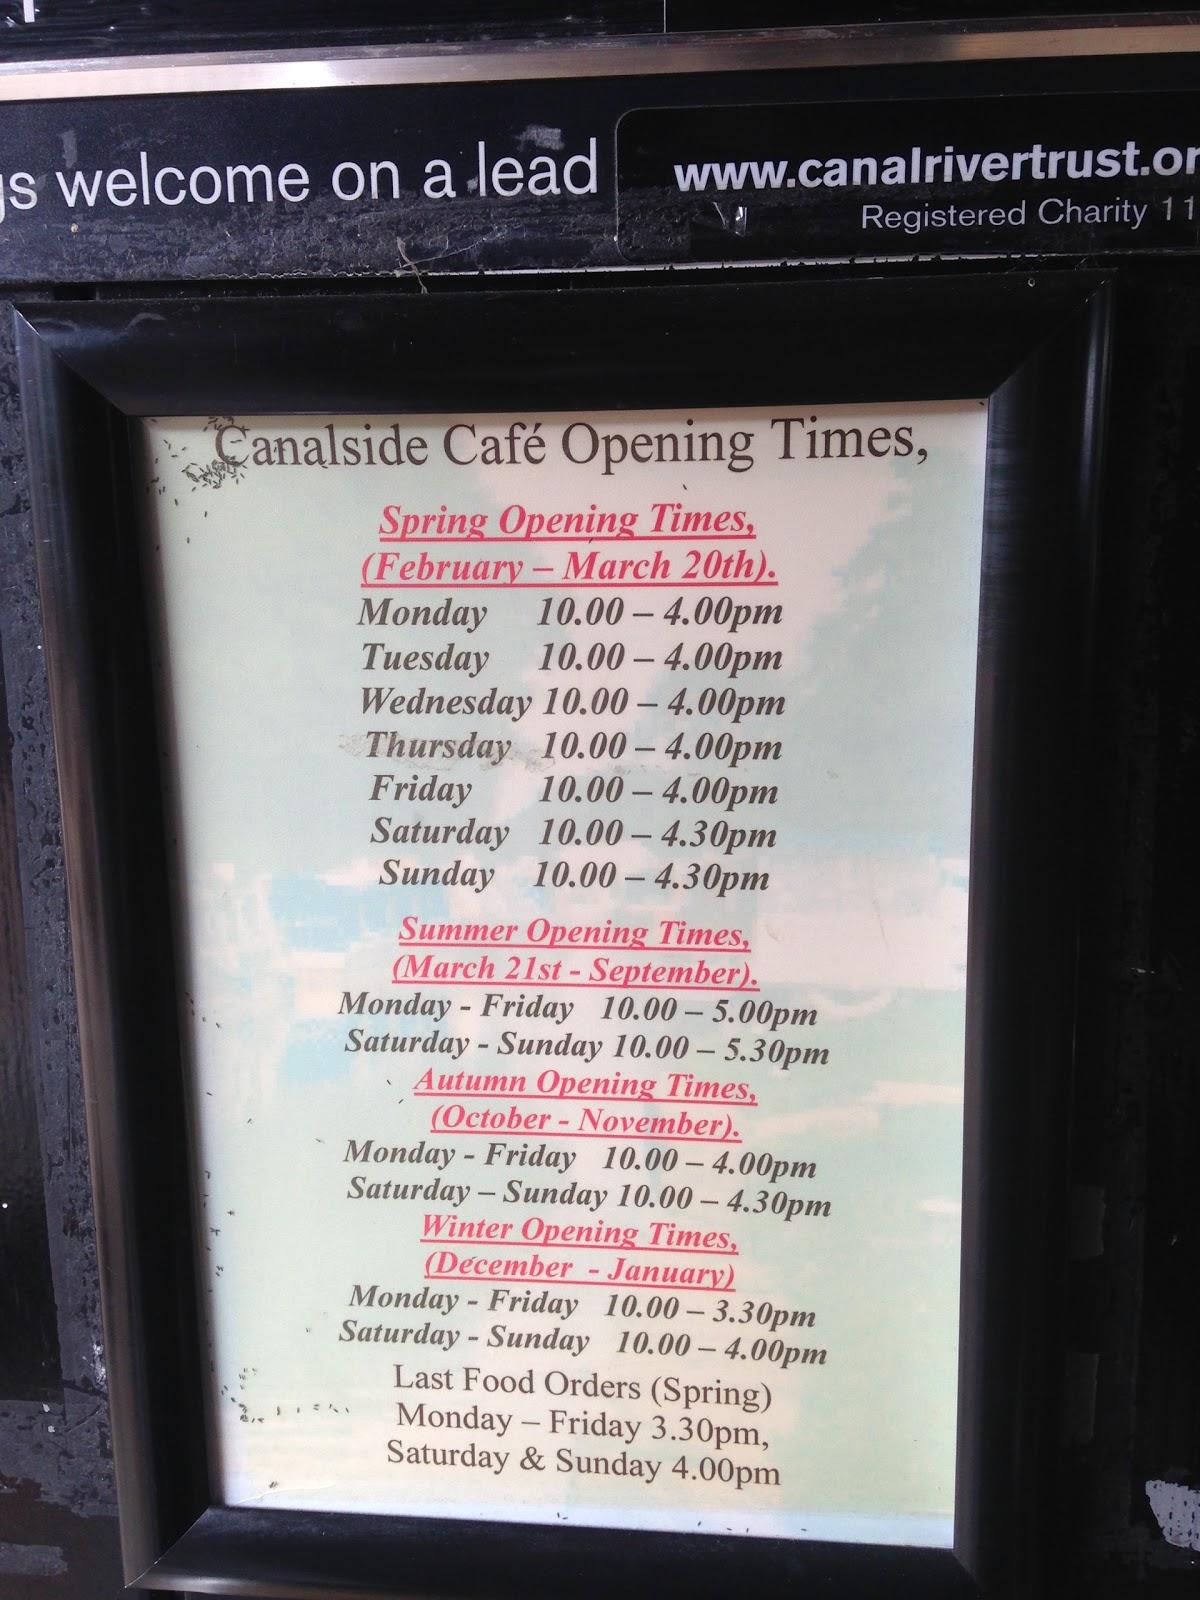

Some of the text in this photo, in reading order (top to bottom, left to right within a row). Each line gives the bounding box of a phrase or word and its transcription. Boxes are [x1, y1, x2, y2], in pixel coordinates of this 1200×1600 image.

[0, 137, 597, 223] s welcome on a lead
[862, 200, 1025, 234] Registered
[1039, 197, 1147, 229] Charity
[215, 417, 930, 475] Canalside Café Opening Times,
[379, 503, 757, 540] Spring Opening Times,
[360, 552, 525, 587] (February
[563, 550, 674, 581] March
[684, 550, 779, 585] 20th).
[358, 598, 487, 633] Monday
[537, 597, 624, 625] 10.00
[664, 597, 782, 633] 4.00pm
[363, 643, 489, 678] Tuesday
[539, 643, 625, 670] 10.00
[664, 643, 782, 678] 4.00pm
[362, 687, 532, 722] Wednesday
[543, 688, 628, 715] 10.00
[668, 688, 785, 723] 4.00pm
[367, 731, 512, 766] Thursday
[541, 732, 626, 759] 10.00
[665, 732, 782, 768] 4.00pm
[369, 775, 472, 808] Friday
[539, 776, 623, 802] 10.00
[663, 777, 778, 811] 4.00pm
[370, 817, 509, 851] Saturday
[539, 819, 623, 845] 10.00
[661, 820, 776, 855] 4.30pm
[379, 859, 495, 893] Sunday
[533, 861, 616, 888] 10.00
[655, 863, 769, 897] 4.30pm
[398, 916, 751, 952] Summer Opening Times,
[392, 954, 495, 984] (March
[504, 956, 561, 982] 21st
[589, 958, 759, 990] September).
[338, 992, 451, 1022] Monday
[480, 994, 574, 1024] Friday
[602, 996, 677, 1021] 10.00
[712, 1000, 817, 1031] 5.00pm
[345, 1029, 470, 1060] Saturday
[497, 1032, 603, 1063] Sunday
[615, 1035, 689, 1059] 10.00
[725, 1038, 829, 1070] 5.30pm
[413, 1068, 758, 1106] Autumn Opening Times,
[430, 1104, 552, 1135] (October
[578, 1109, 742, 1142] November).
[343, 1140, 455, 1170] Monday
[485, 1143, 576, 1174] Friday
[603, 1147, 678, 1171] 10.00
[712, 1151, 816, 1183] 4.00pm
[347, 1176, 470, 1207] Saturday
[503, 1180, 608, 1212] Sunday
[617, 1184, 692, 1209] 10.00
[727, 1189, 831, 1221] 4.30pm
[420, 1214, 739, 1255] Winter Opening Times,
[424, 1252, 573, 1280] (December
[607, 1258, 736, 1291] January)
[349, 1285, 459, 1315] Monday
[488, 1289, 578, 1320] Friday
[606, 1294, 679, 1319] 10.00
[713, 1300, 815, 1332] 3.30pm
[339, 1320, 460, 1351] Saturday
[487, 1325, 590, 1357] Sunday
[618, 1331, 690, 1356] 10.00
[725, 1337, 827, 1369] 4.00pm
[394, 1365, 771, 1413] Last Food Orders (Spring)
[397, 1403, 512, 1437] Monday
[550, 1410, 641, 1444] Friday
[652, 1416, 768, 1450] 3.30pm,
[388, 1440, 780, 1490] Saturday & Sunday 4.00pm
